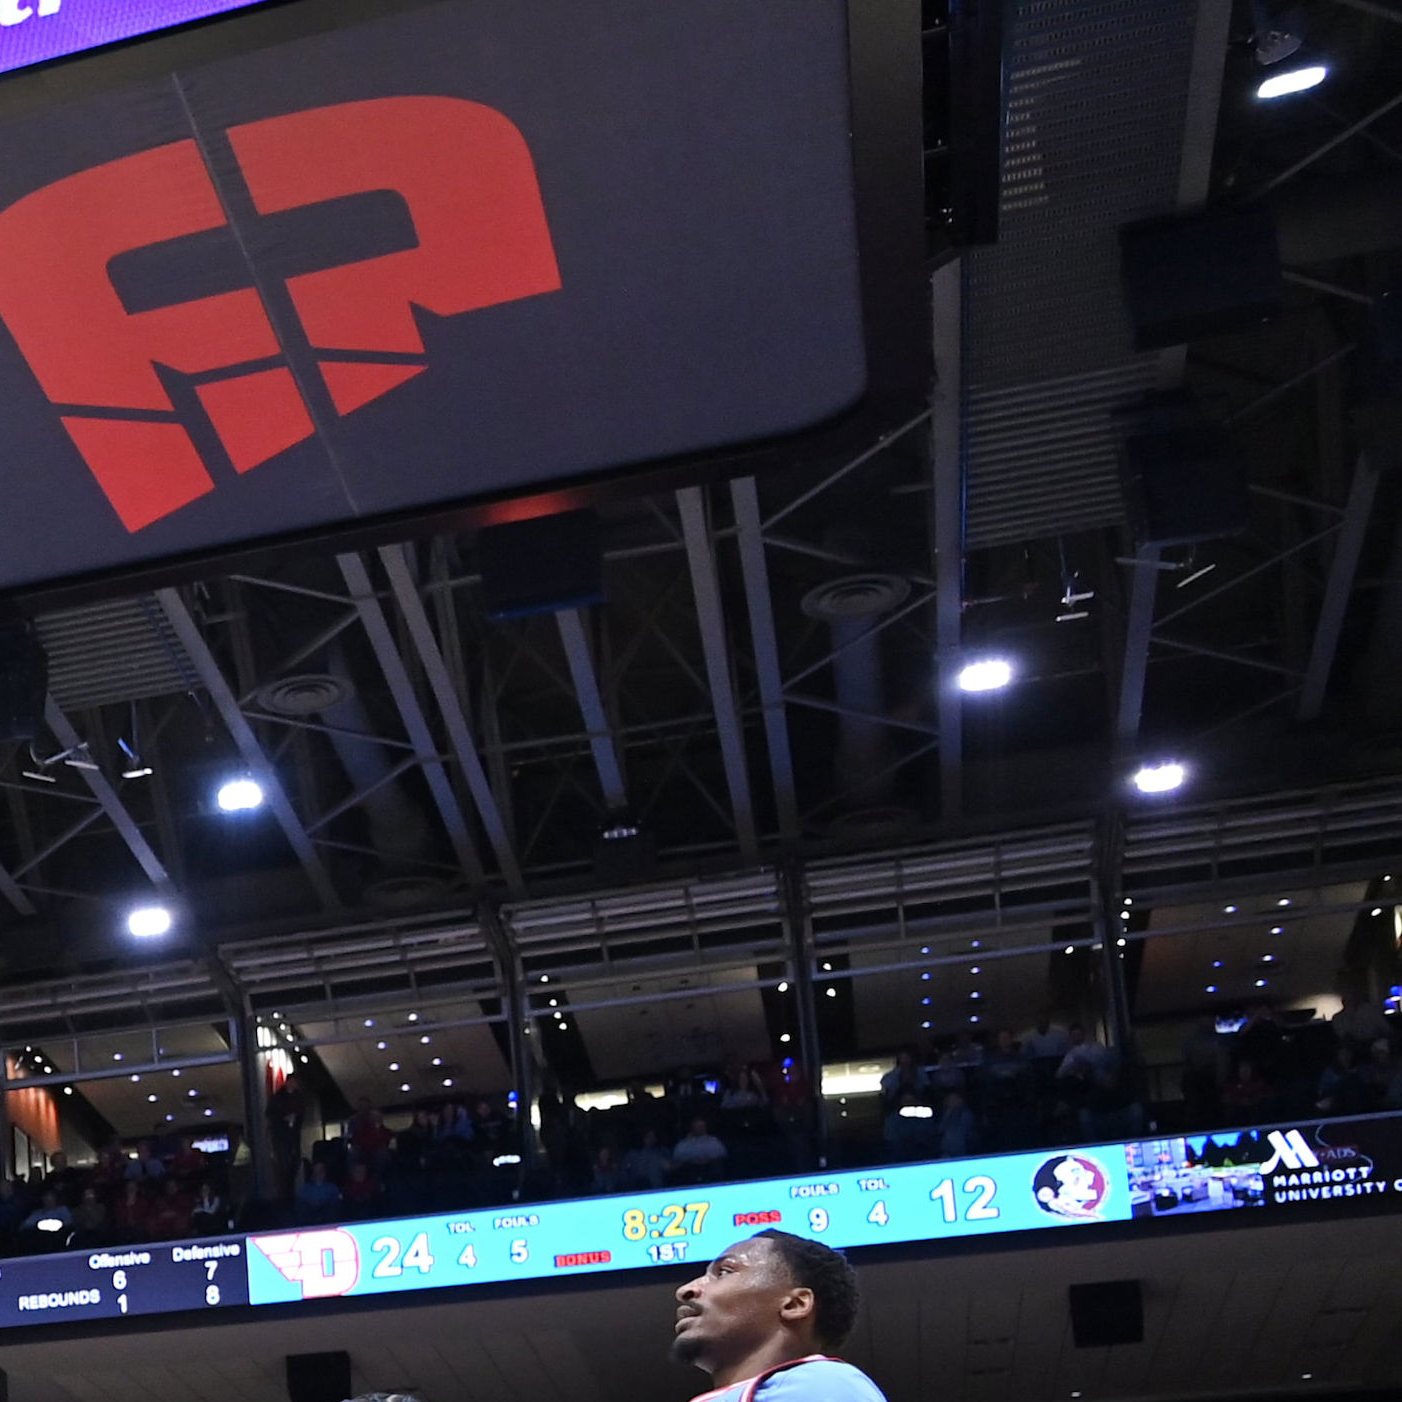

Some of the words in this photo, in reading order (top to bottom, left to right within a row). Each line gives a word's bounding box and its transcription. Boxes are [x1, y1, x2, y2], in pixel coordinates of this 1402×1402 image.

[1272, 1166, 1371, 1187] MARRIOTT
[789, 1181, 840, 1199] FOULS
[929, 1175, 999, 1223] 12
[1274, 1181, 1386, 1203] UNIVERSITY
[493, 1215, 539, 1230] FOULS
[622, 1202, 710, 1241] 8:27
[733, 1210, 782, 1227] POSS
[808, 1208, 829, 1232] 9
[867, 1200, 889, 1226] 4
[89, 1250, 151, 1270] Offensive
[172, 1243, 241, 1263] Defensive
[371, 1232, 435, 1279] 24
[457, 1243, 477, 1268] 4
[509, 1239, 529, 1264] 5
[554, 1250, 612, 1269] BONUS
[646, 1242, 689, 1262] 1ST
[113, 1270, 127, 1289] 6
[204, 1261, 218, 1280] 7
[18, 1289, 101, 1311] REBOUNDS
[117, 1294, 128, 1314] 1
[206, 1285, 220, 1305] 8
